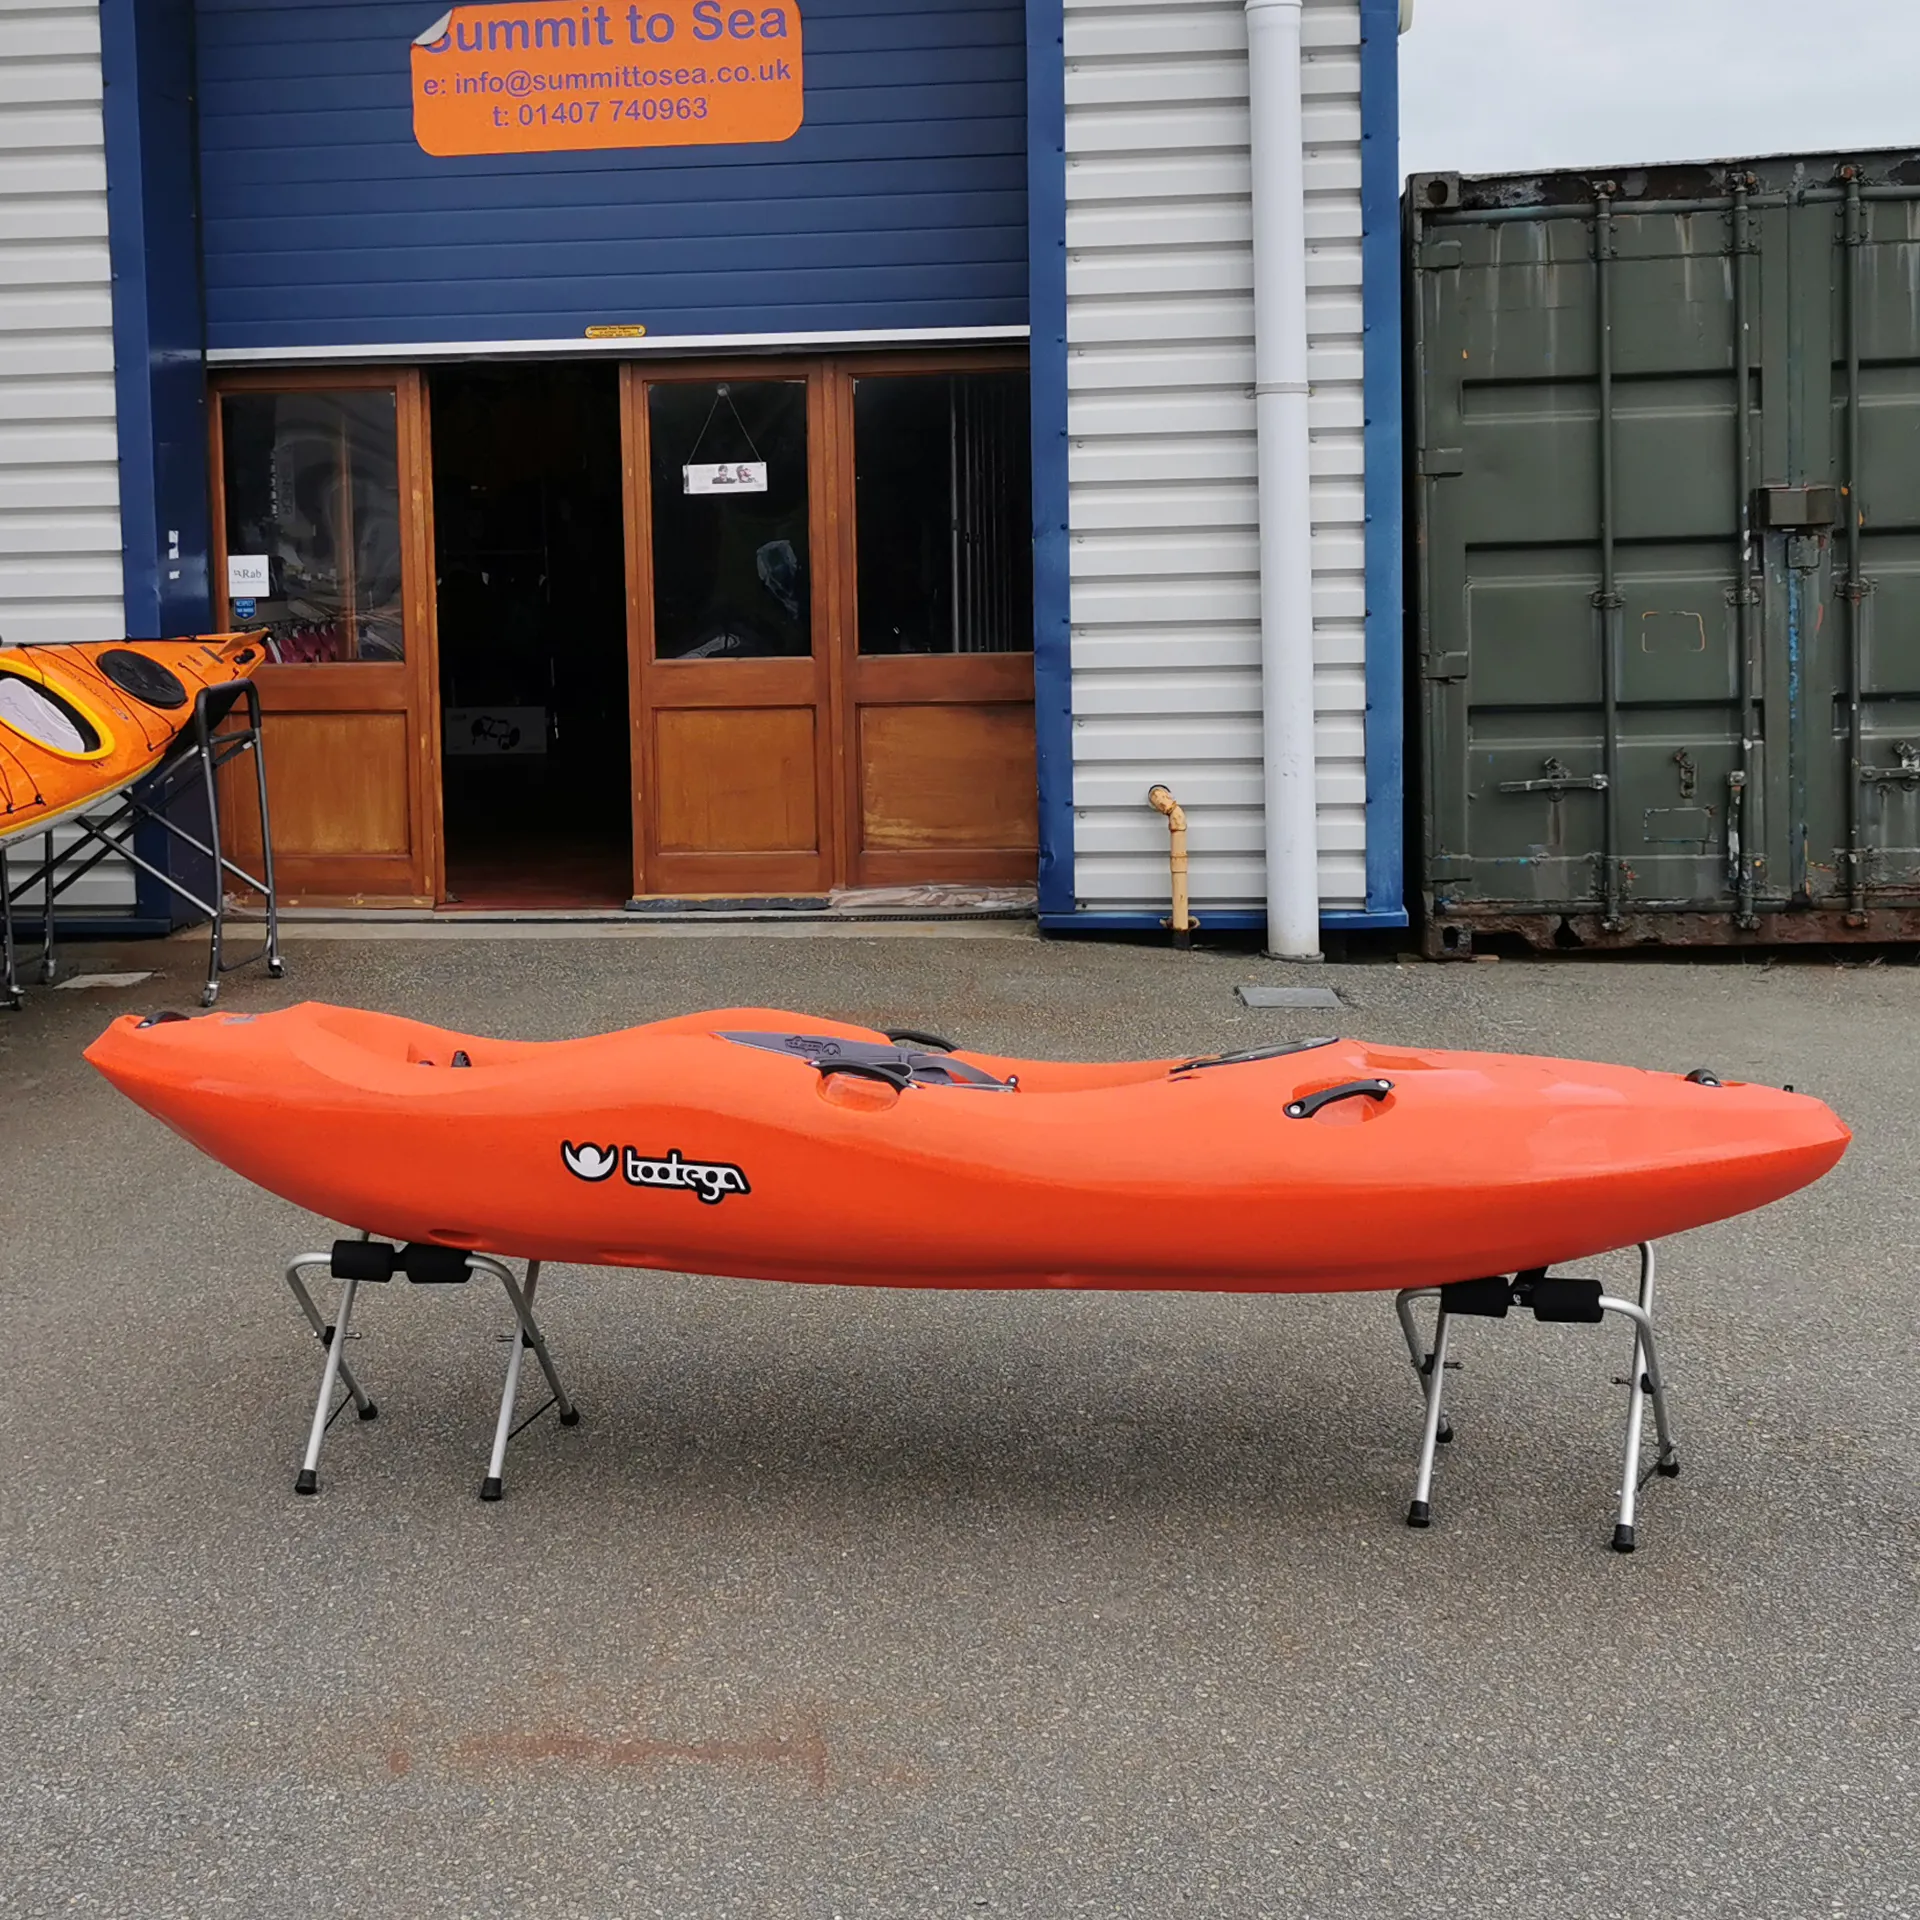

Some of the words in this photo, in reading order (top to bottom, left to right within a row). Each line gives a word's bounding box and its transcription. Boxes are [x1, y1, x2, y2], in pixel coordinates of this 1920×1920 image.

[626, 5, 675, 45] to
[692, 0, 787, 41] Sea
[424, 78, 447, 96] e:
[455, 59, 792, 97] info@summittosea.co.uk
[493, 106, 509, 127] t:
[518, 102, 600, 126] 01407
[609, 97, 708, 122] 740963
[242, 569, 261, 579] Rab
[625, 1149, 747, 1201] tootega
